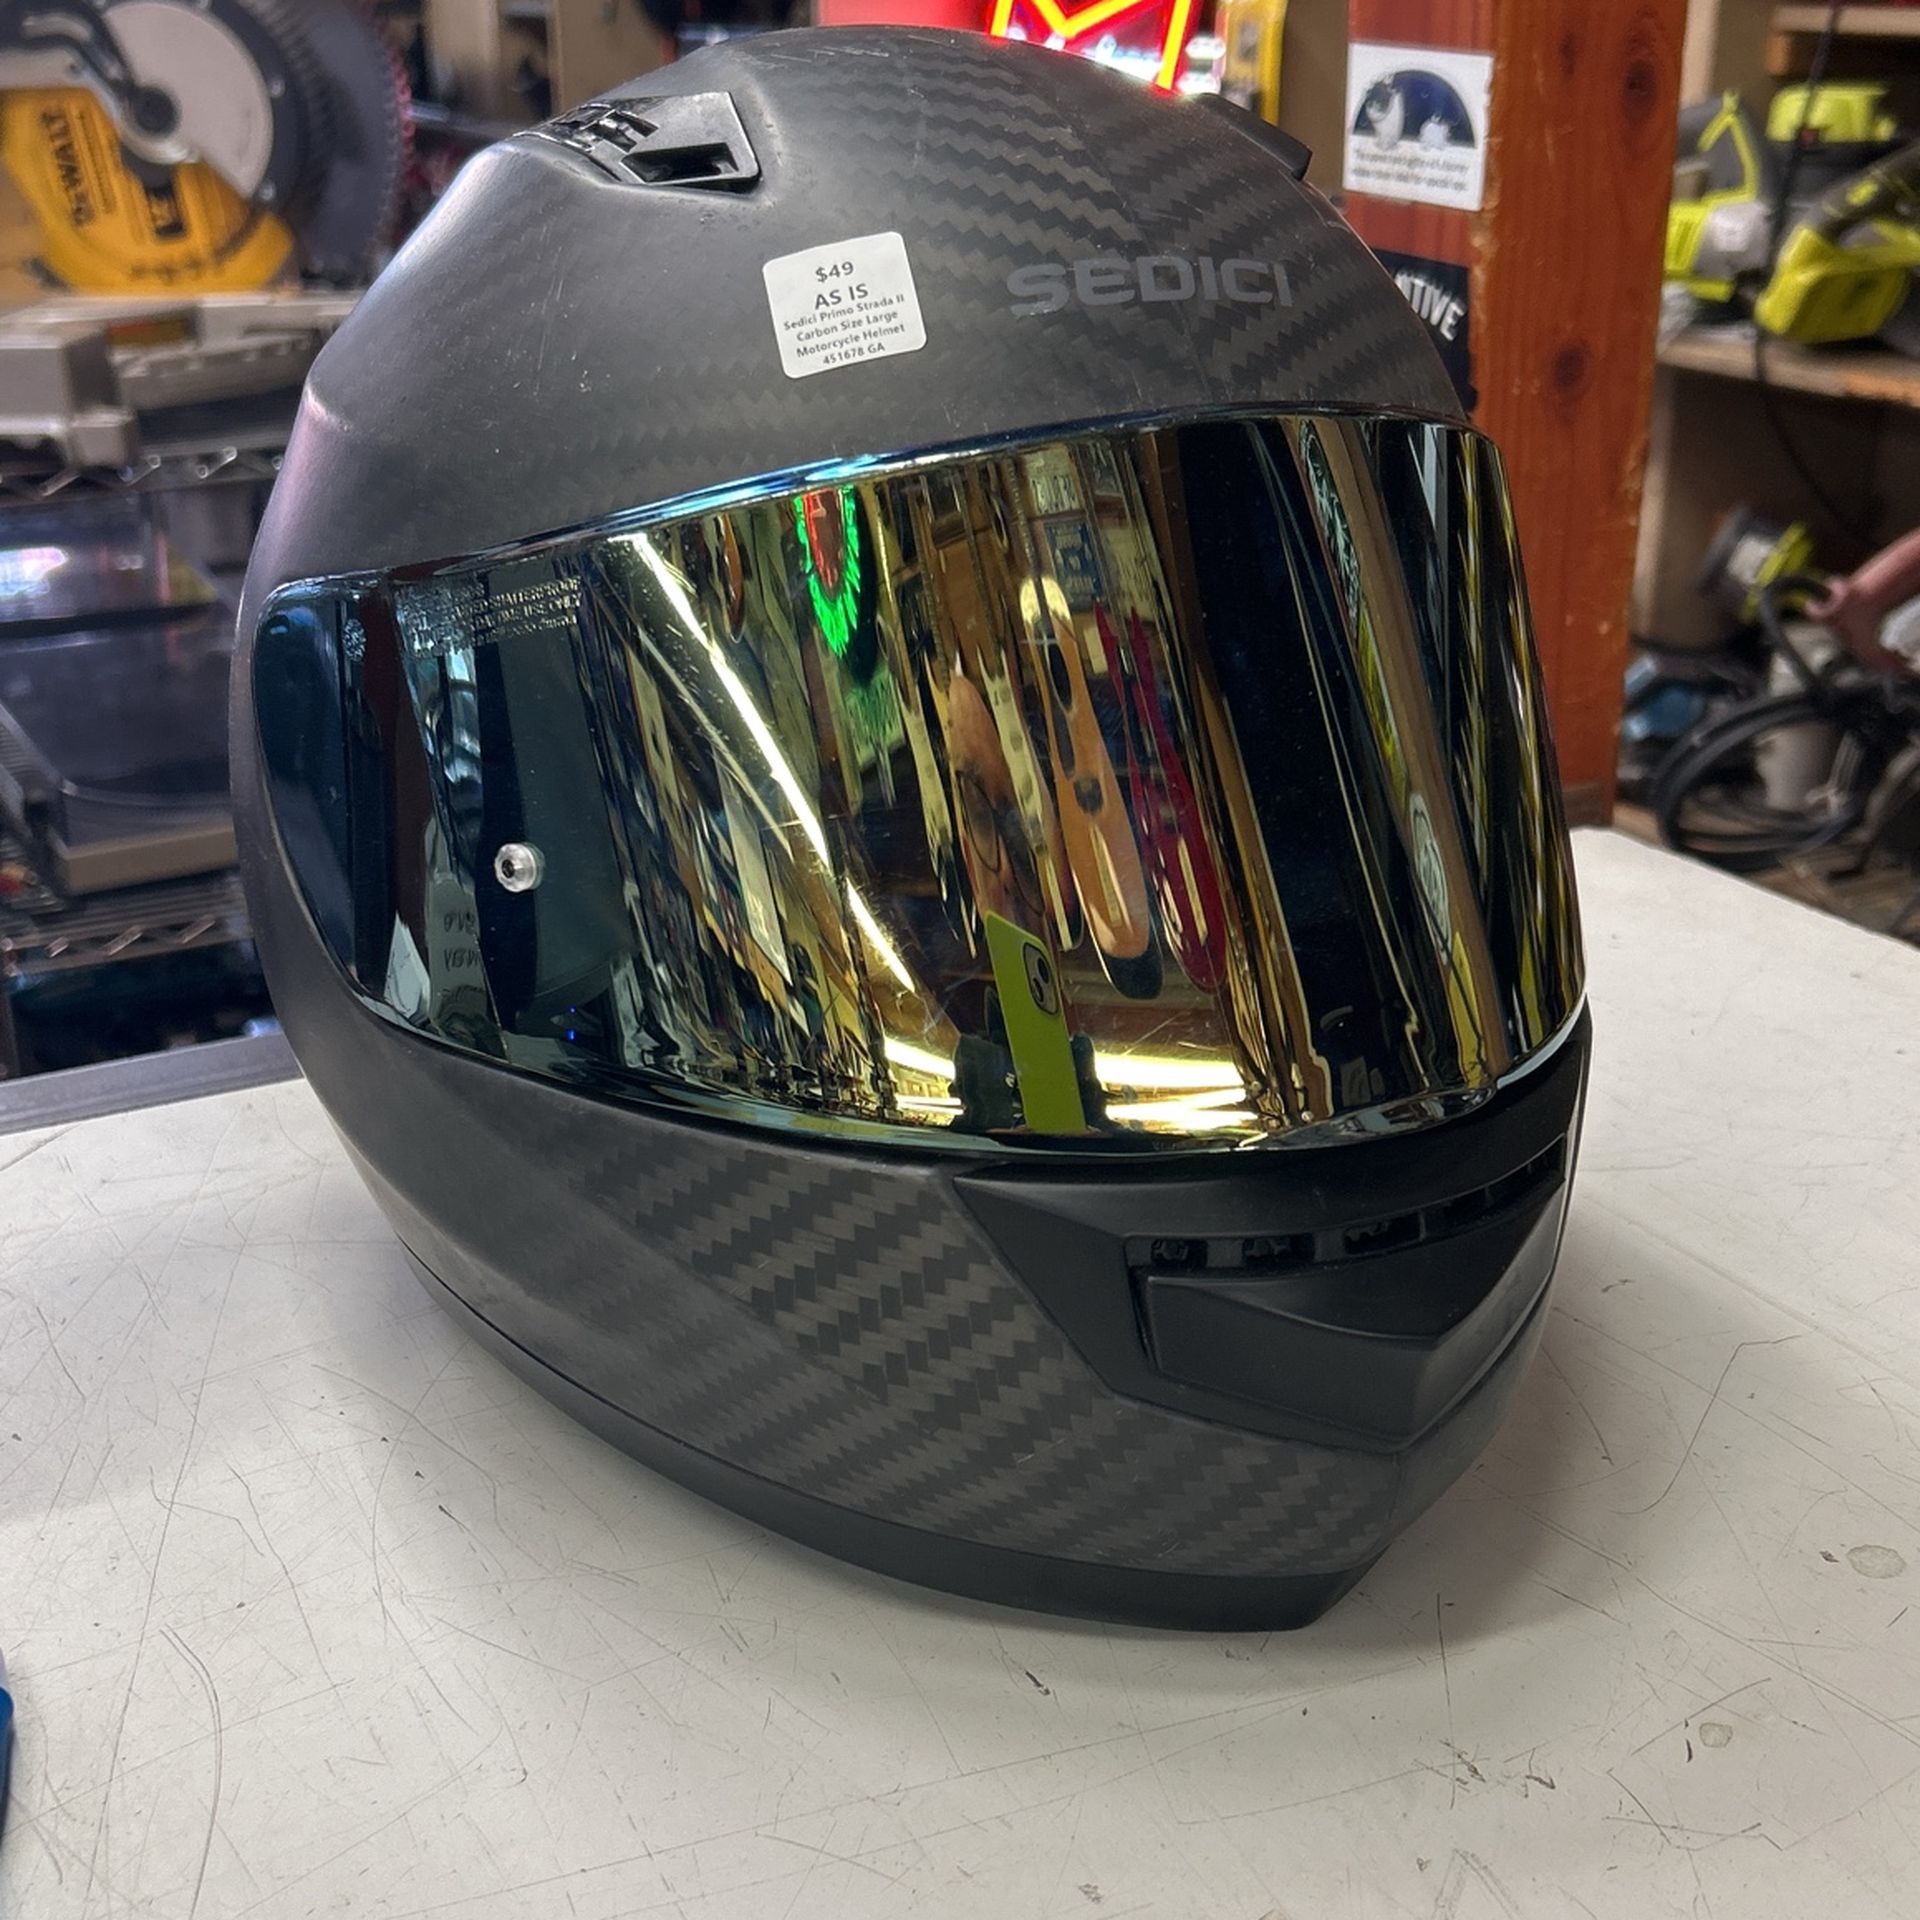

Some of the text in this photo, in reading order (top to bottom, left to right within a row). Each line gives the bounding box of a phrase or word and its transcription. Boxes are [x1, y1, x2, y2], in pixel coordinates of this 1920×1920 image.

[815, 261, 854, 283] $49
[1006, 255, 1293, 317] SEDICI
[815, 283, 869, 310] AS IS
[783, 313, 817, 331] Sedici
[819, 307, 854, 321] Primo
[856, 297, 894, 312] Strada
[796, 311, 898, 342] Carbon Size Large
[796, 324, 906, 358] Motorcycle Helmet
[823, 342, 886, 365] 451678 GA
